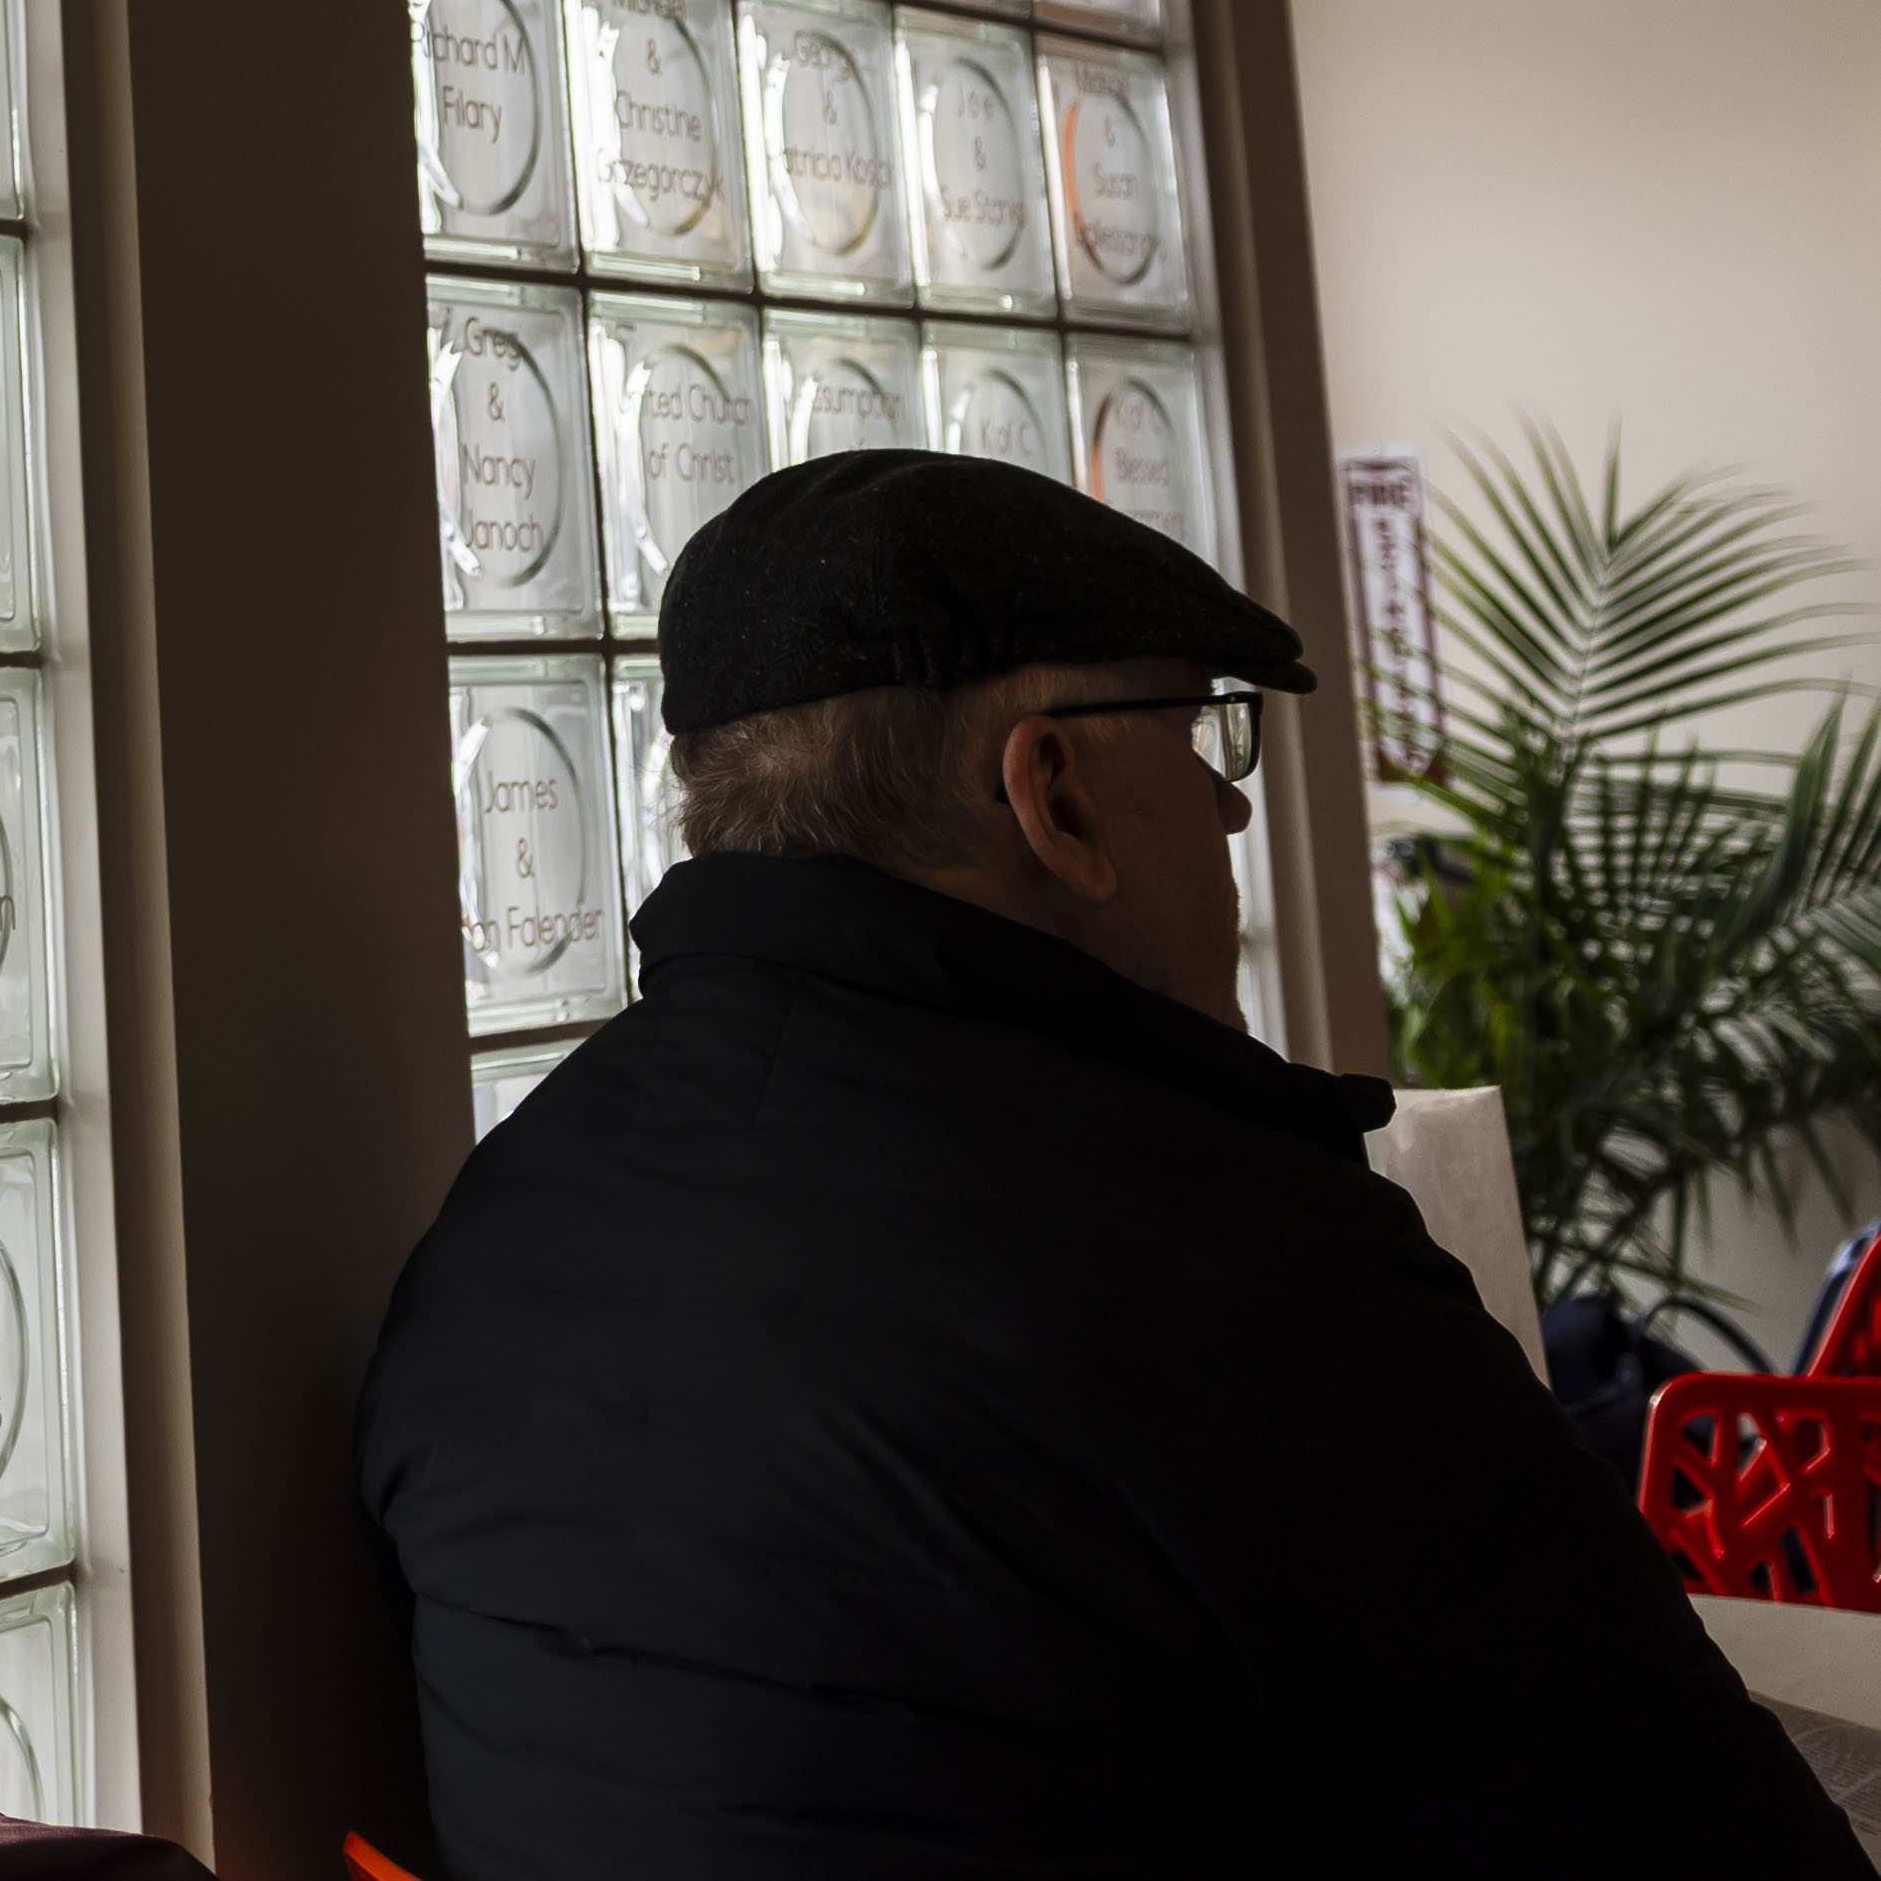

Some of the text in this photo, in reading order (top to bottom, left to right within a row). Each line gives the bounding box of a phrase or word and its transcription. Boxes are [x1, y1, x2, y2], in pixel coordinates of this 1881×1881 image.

[616, 90, 702, 143] Christine
[489, 383, 505, 421] &
[463, 444, 535, 501] Nancy
[677, 444, 735, 487] Christ
[485, 771, 558, 813] James
[515, 838, 535, 878] &
[507, 905, 604, 949] Falender
